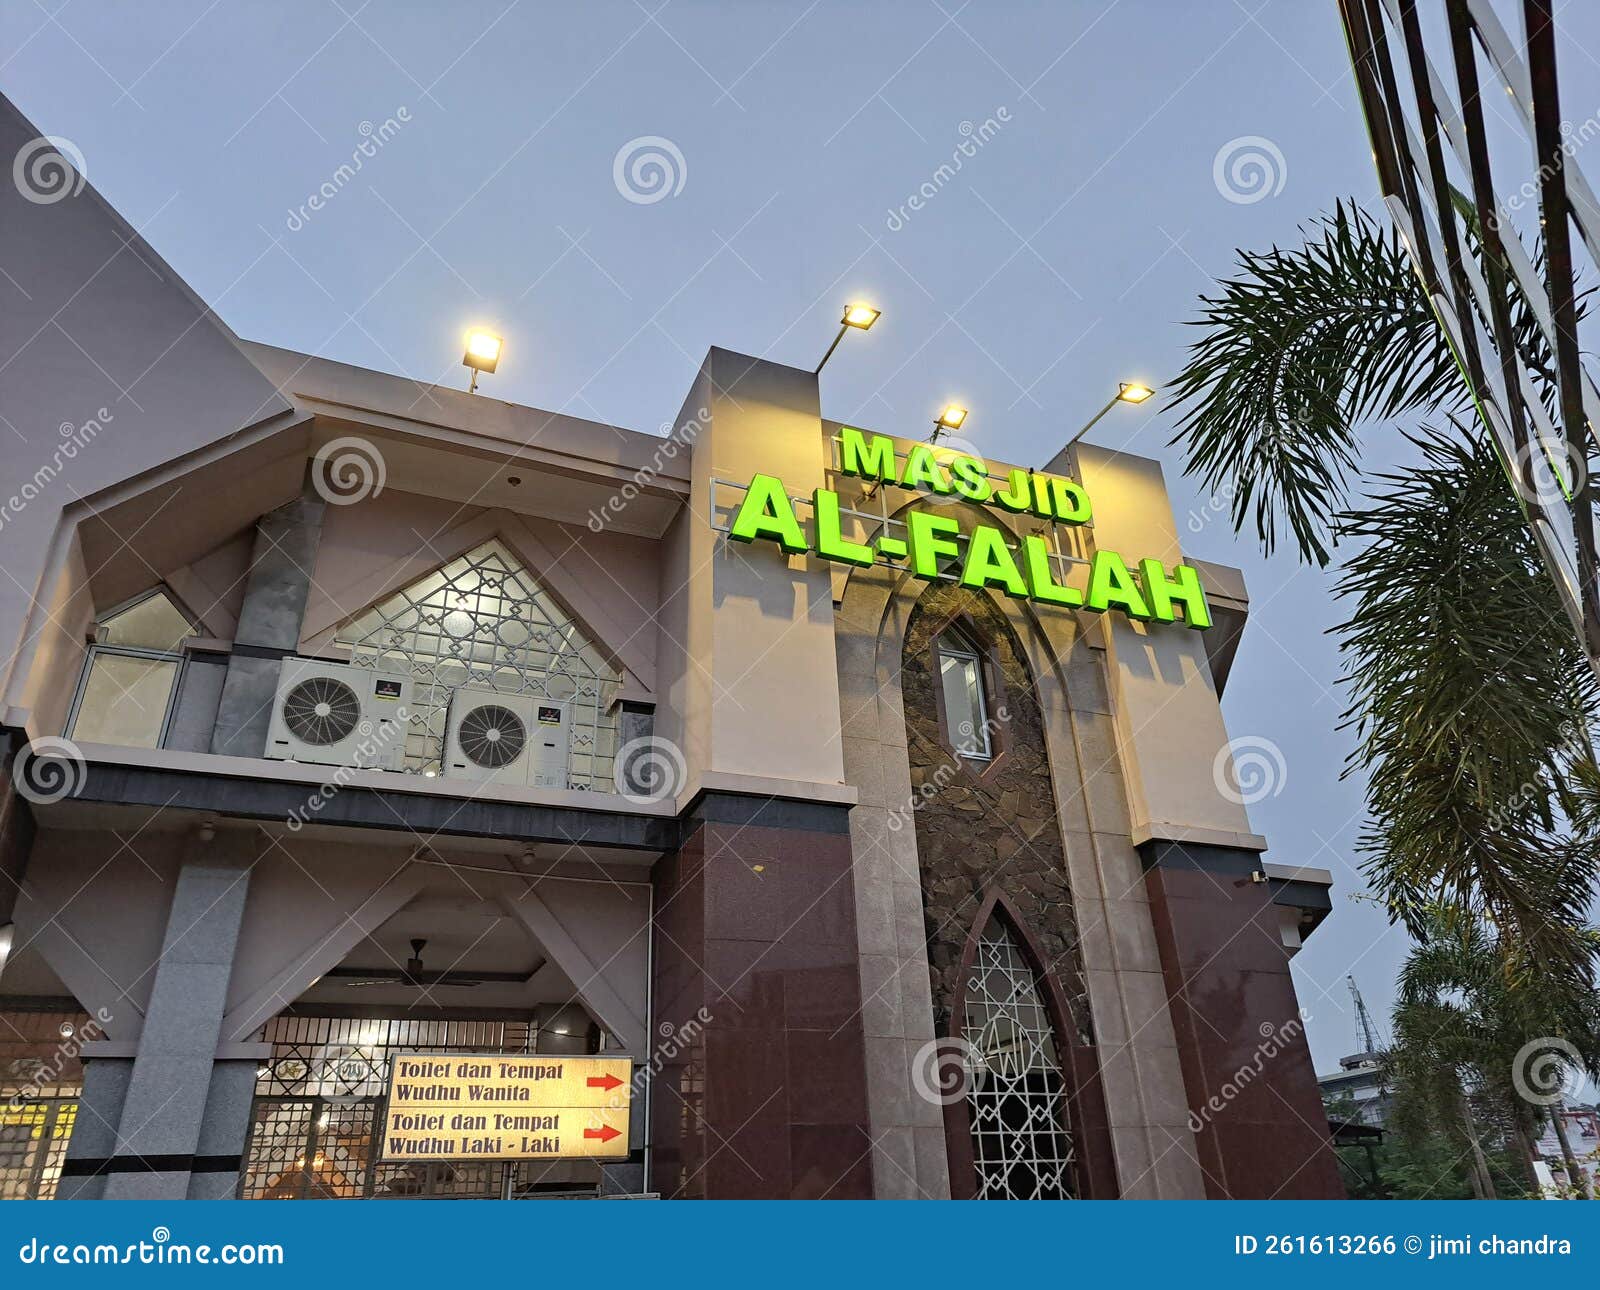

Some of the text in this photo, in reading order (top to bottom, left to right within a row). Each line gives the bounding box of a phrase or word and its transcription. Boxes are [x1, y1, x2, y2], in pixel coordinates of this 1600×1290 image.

[839, 427, 1093, 526] MASJID
[728, 472, 1214, 630] AL-FALAH
[399, 1061, 563, 1081] Toilet dan Tempat
[397, 1084, 530, 1101] Wudhu Wanita
[392, 1113, 559, 1132] Toilet dan Tempat
[389, 1137, 454, 1154] Wudhu
[461, 1137, 502, 1154] Laki
[521, 1136, 560, 1153] Laki
